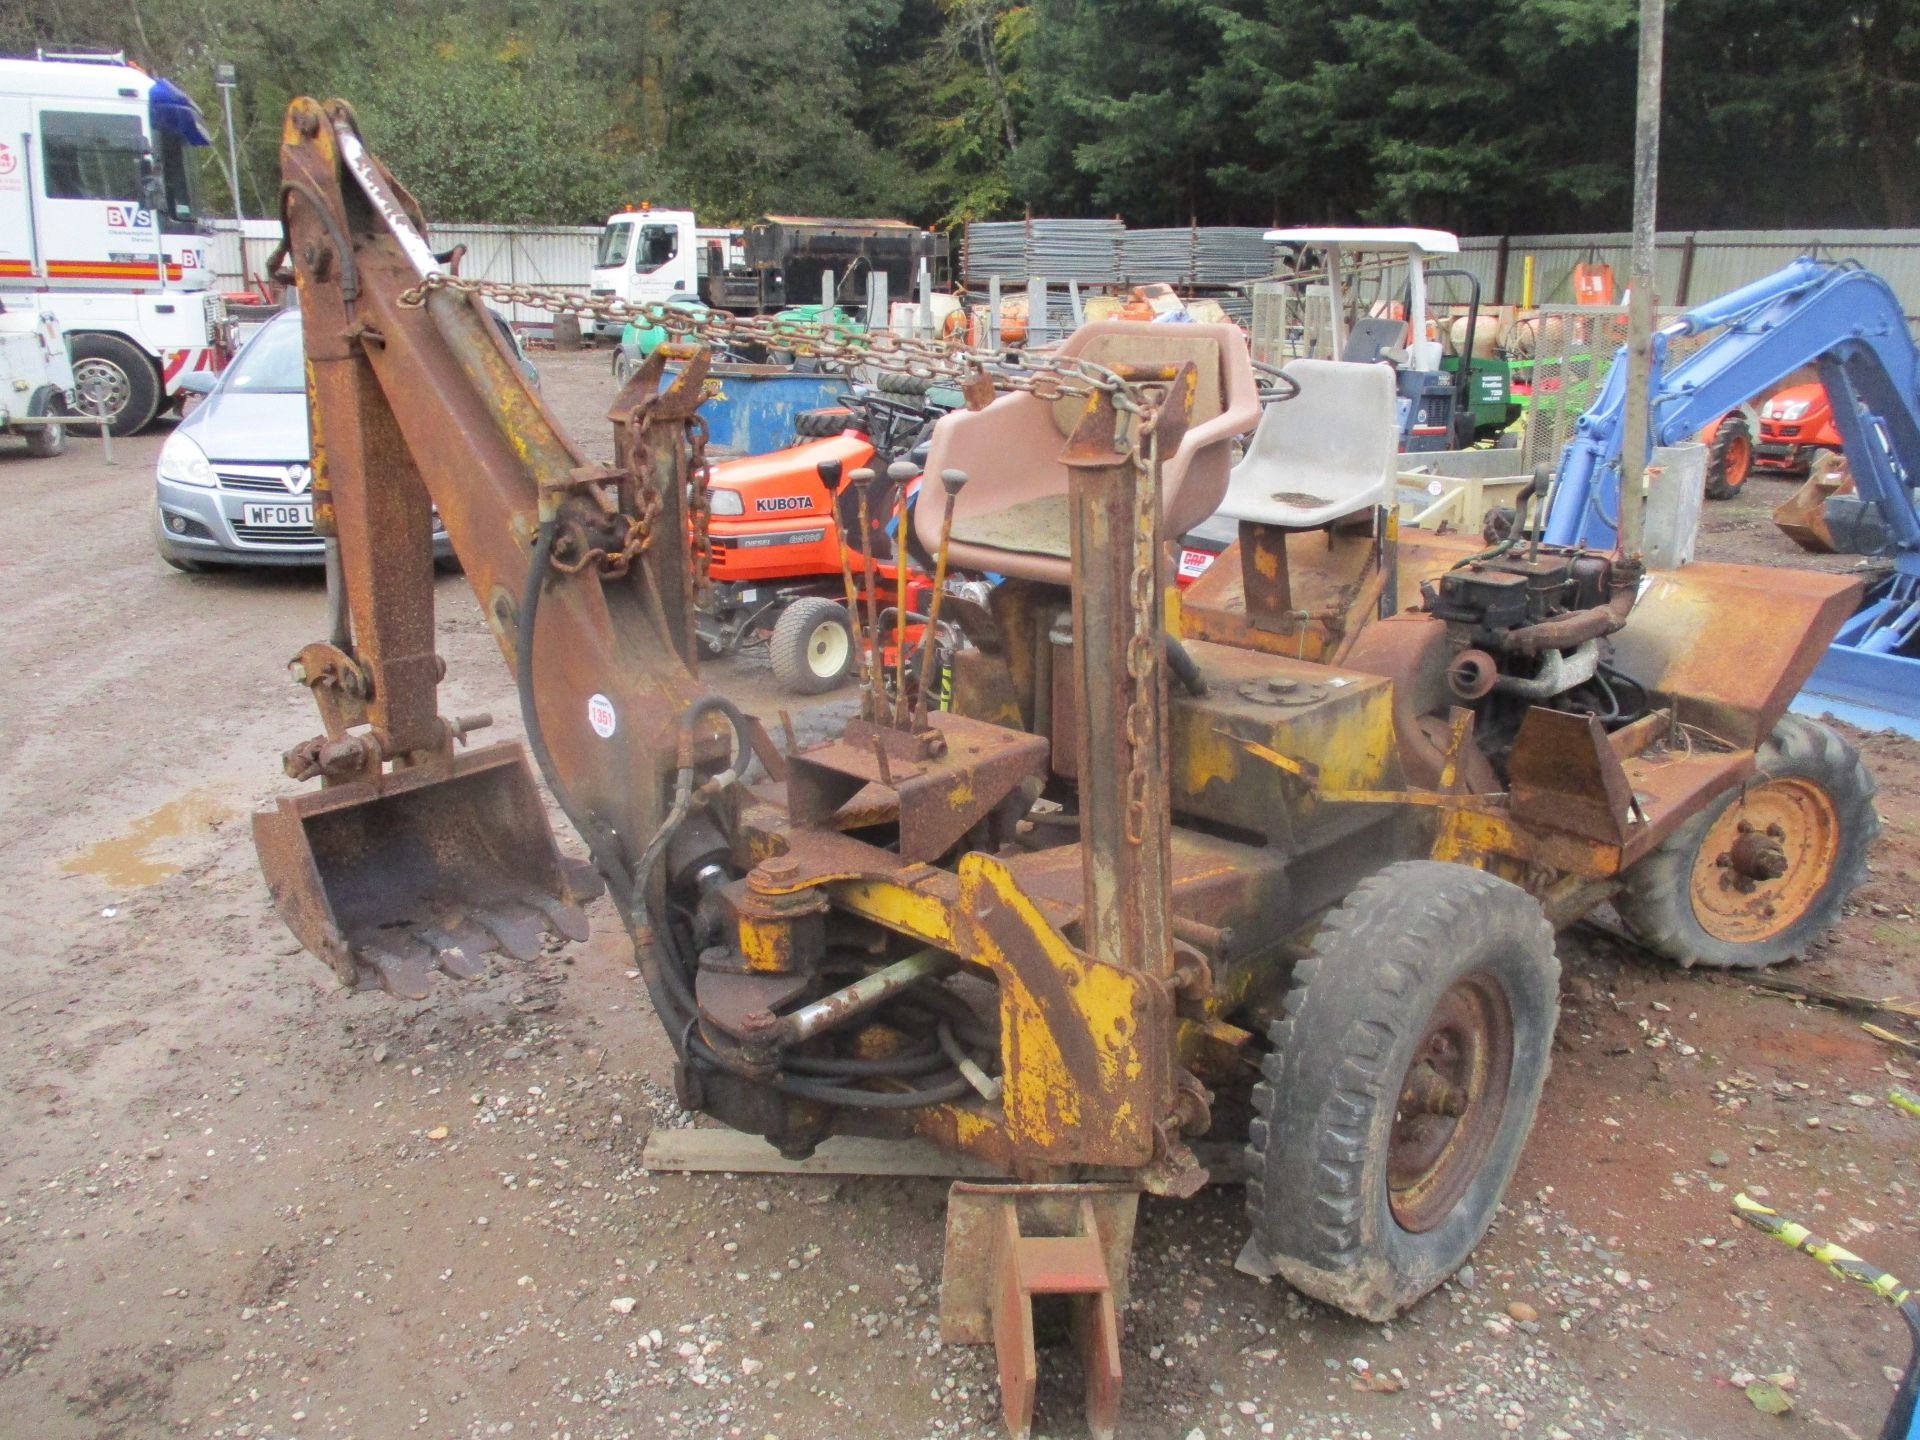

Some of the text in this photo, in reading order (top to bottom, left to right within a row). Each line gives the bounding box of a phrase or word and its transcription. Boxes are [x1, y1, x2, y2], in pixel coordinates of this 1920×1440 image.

[107, 207, 152, 227] BVS
[756, 496, 814, 512] KUBOTA
[252, 507, 300, 523] WF08
